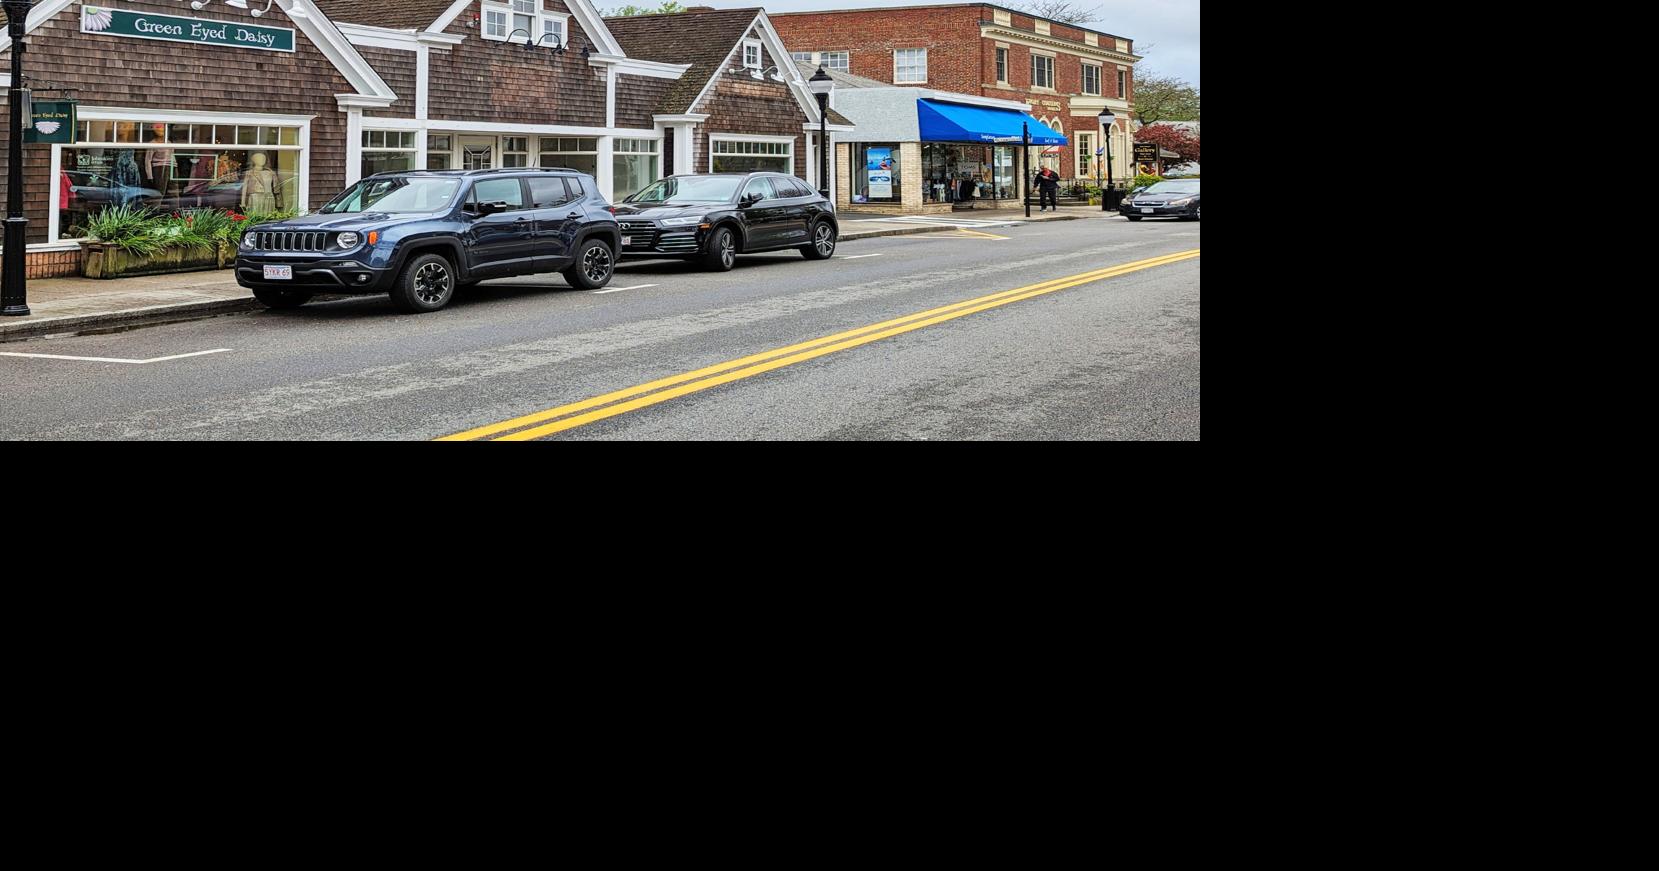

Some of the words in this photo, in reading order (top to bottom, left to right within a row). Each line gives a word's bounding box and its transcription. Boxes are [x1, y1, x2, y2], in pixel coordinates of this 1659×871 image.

[134, 18, 183, 35] Green
[190, 22, 227, 41] Eyed
[234, 29, 275, 47] Daisy
